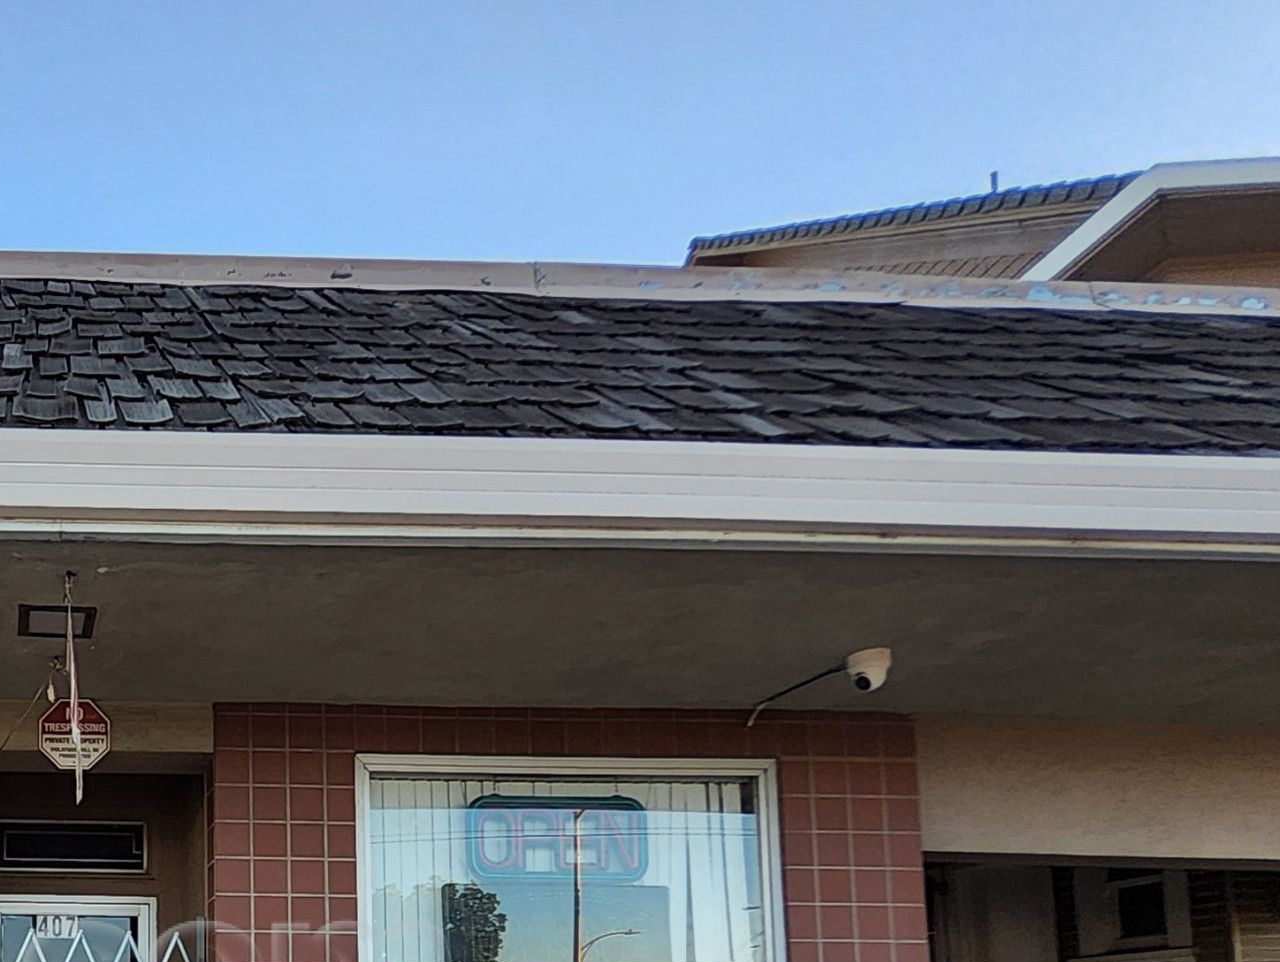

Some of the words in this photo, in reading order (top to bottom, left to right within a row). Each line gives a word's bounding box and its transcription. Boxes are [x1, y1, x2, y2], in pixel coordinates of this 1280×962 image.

[44, 723, 106, 732] TRESPSSING
[476, 807, 641, 871] OPEN
[37, 915, 76, 937] 407
